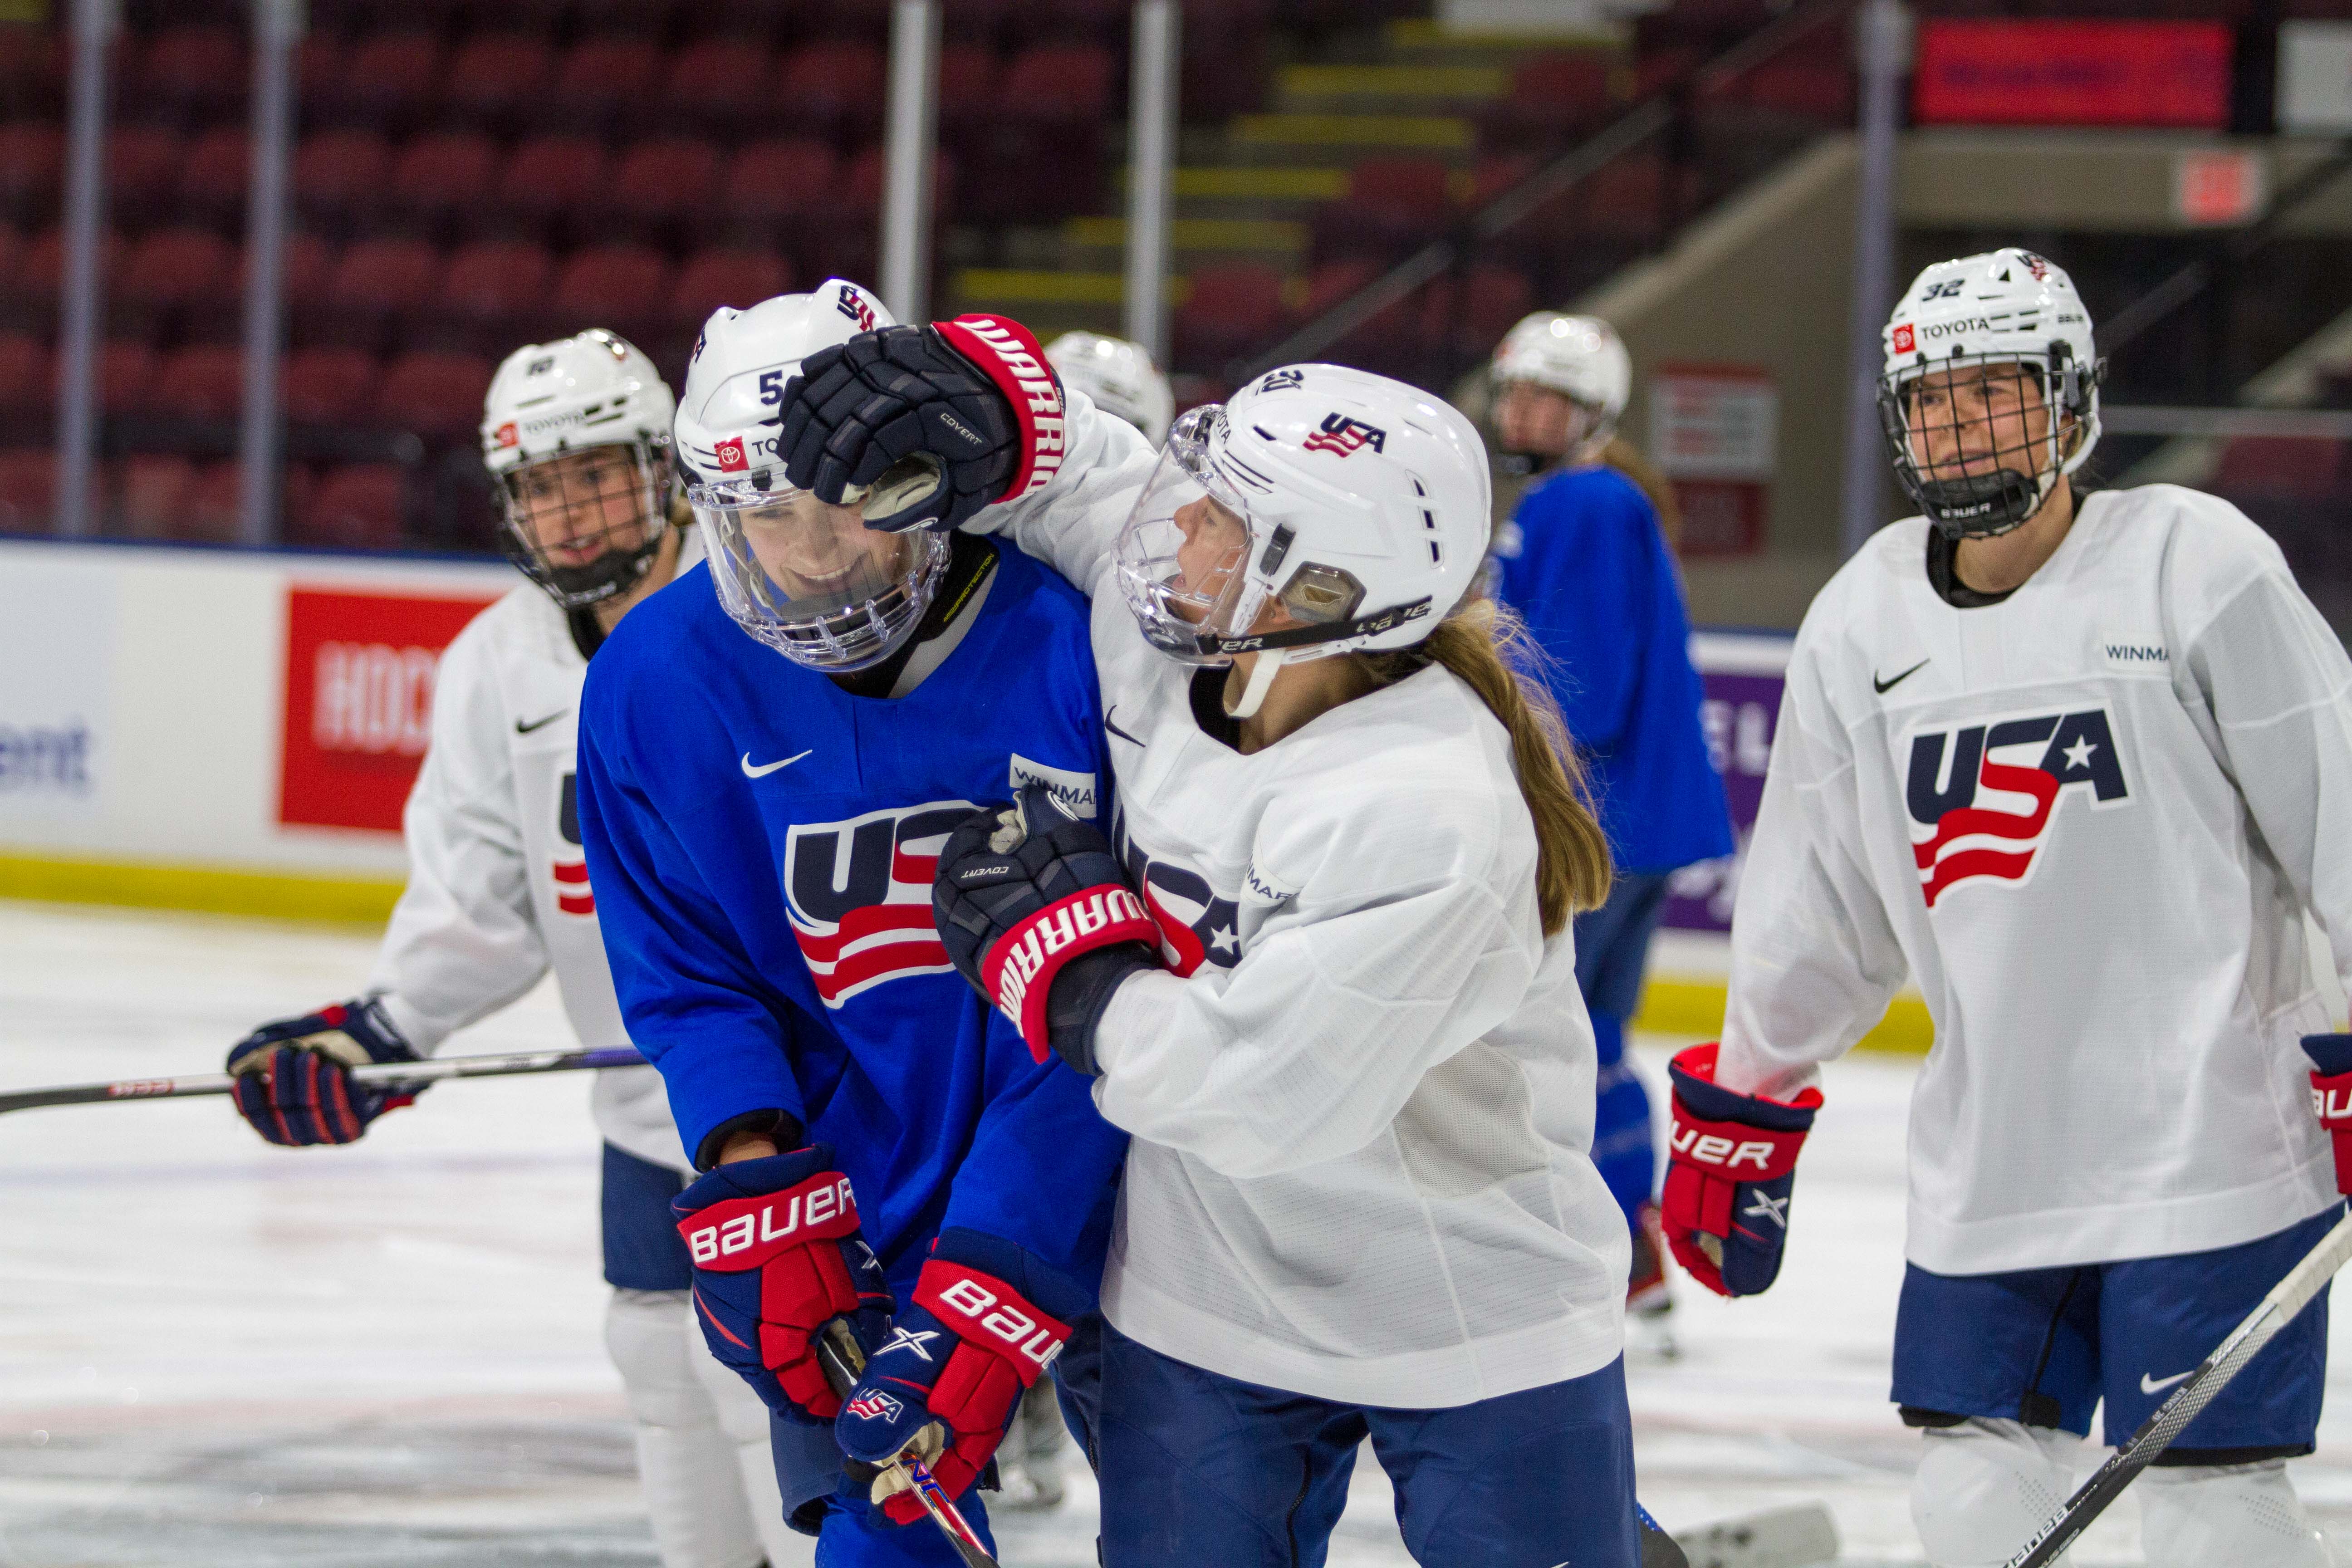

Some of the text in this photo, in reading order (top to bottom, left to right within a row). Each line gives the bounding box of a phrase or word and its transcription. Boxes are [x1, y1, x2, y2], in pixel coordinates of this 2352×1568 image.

[1921, 278, 1965, 302] 32
[1921, 318, 1990, 340] TOYOTA
[954, 319, 1064, 495] WARRIO
[751, 438, 779, 456] TO
[940, 412, 982, 446] COVERT
[1302, 411, 1387, 458] USA
[1219, 637, 1264, 651] ER
[1906, 706, 2131, 909] USA
[960, 866, 1009, 879] COVERT
[785, 800, 988, 1009] US
[1671, 1121, 1775, 1170] UER
[939, 1279, 1064, 1369] BAU
[847, 1387, 904, 1423] USA
